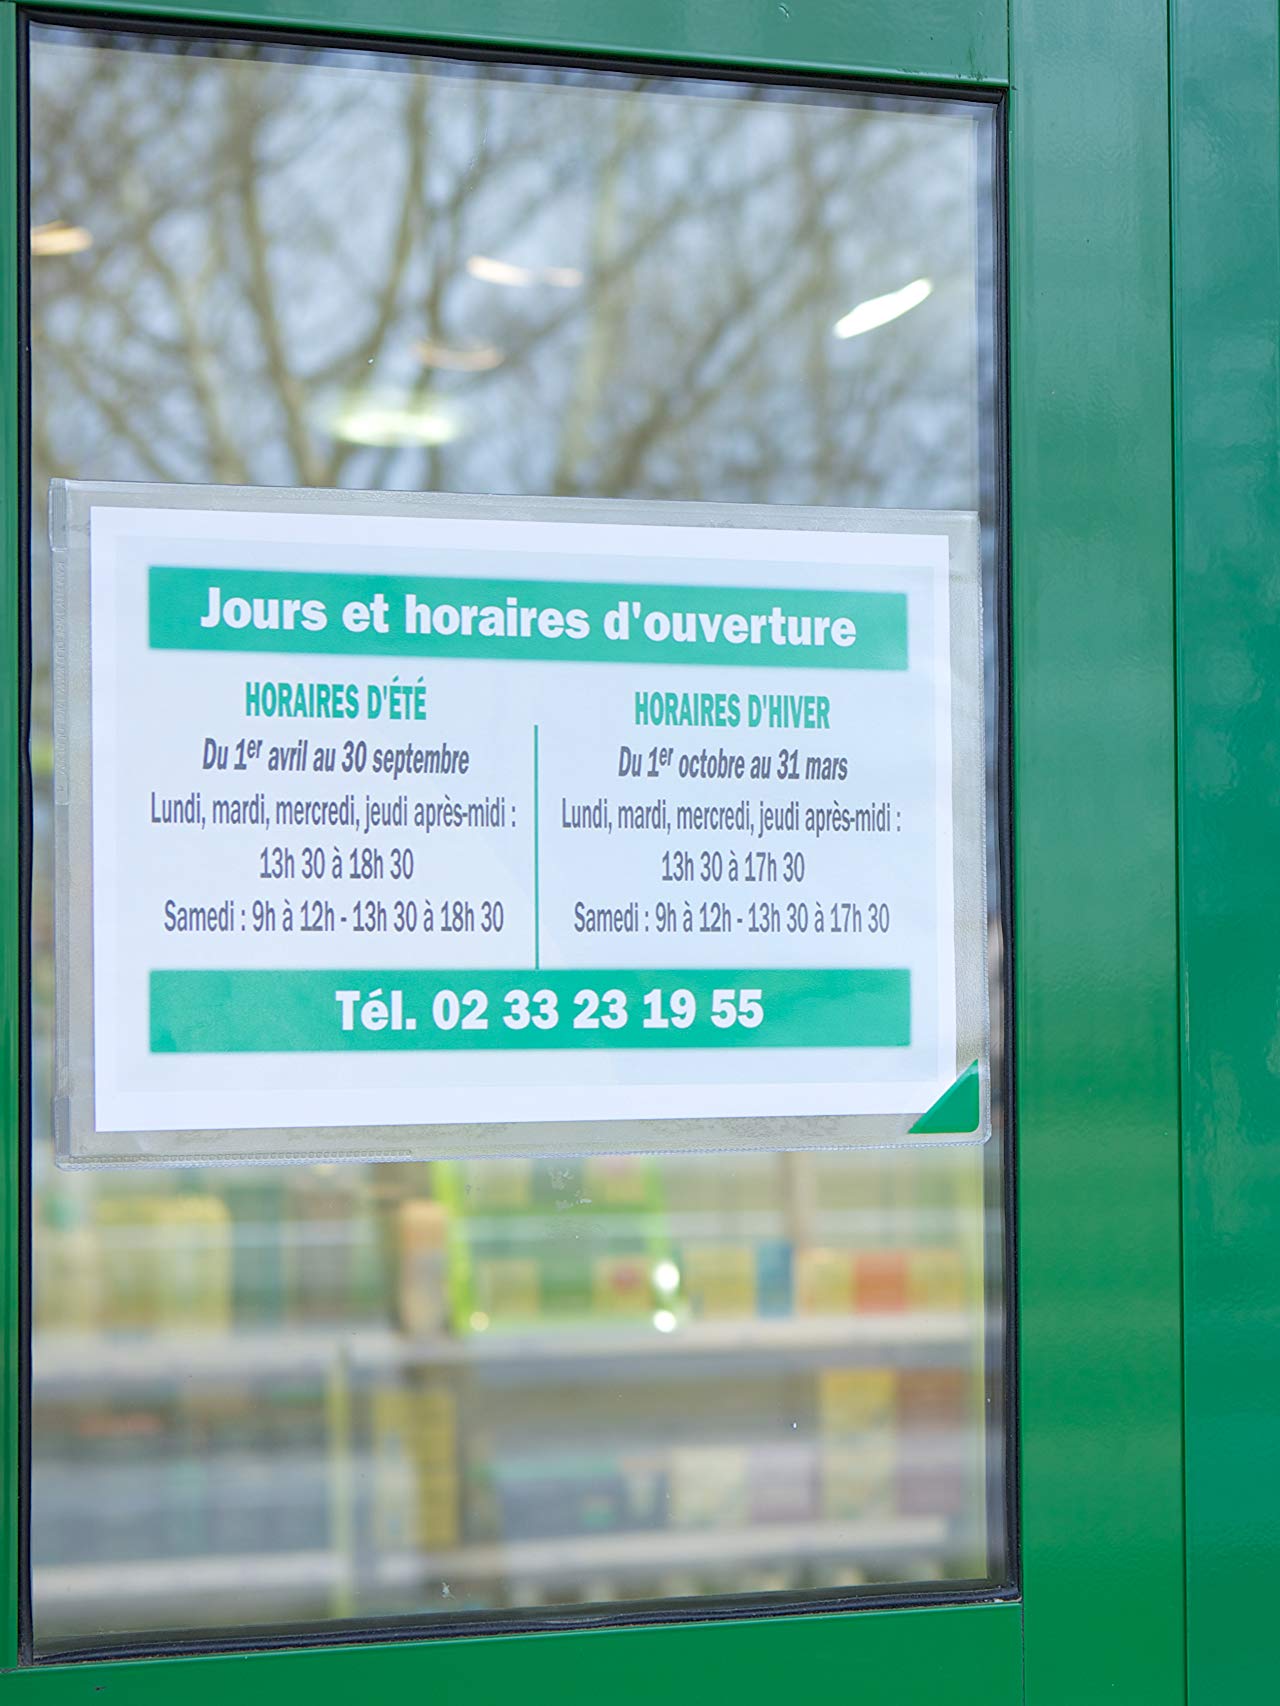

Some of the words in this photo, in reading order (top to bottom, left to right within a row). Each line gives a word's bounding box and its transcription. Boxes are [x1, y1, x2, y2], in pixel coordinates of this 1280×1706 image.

[201, 587, 327, 631] Jours
[342, 594, 389, 633] et
[406, 594, 590, 639] horaires
[604, 601, 856, 646] d'ouverture
[246, 682, 359, 718] HORAIRES
[368, 676, 426, 720] D'ÉTÉ
[636, 692, 740, 727] HORAIRES
[749, 695, 829, 728] D'HIVER
[203, 738, 228, 769] Du
[234, 739, 263, 770] 1er
[268, 740, 308, 771] avril
[313, 748, 336, 772] au
[342, 741, 367, 772] 30
[373, 743, 469, 780] septembre
[619, 746, 642, 777] Du
[647, 747, 673, 777] 1er
[679, 748, 744, 778] octobre
[751, 756, 771, 779] au
[777, 749, 799, 779] 31
[806, 757, 847, 780] mars
[152, 792, 205, 829] Lundi,
[213, 794, 269, 829] mardi,
[277, 795, 359, 830] mercredi,
[364, 795, 407, 834] jeudi
[415, 795, 504, 833] après-midi
[563, 798, 612, 834] Lundi,
[619, 799, 670, 834] mardi,
[677, 801, 754, 835] mercredi,
[758, 801, 799, 838] jeudi
[806, 800, 890, 837] après-midi
[261, 847, 294, 878] 13h
[302, 847, 325, 878] 30
[332, 846, 342, 878] à
[350, 848, 383, 879] 18h
[390, 848, 413, 879] 30
[662, 851, 693, 881] 13h
[701, 851, 722, 881] 30
[729, 850, 738, 881] à
[745, 852, 776, 881] 17h
[783, 852, 804, 882] 30
[165, 900, 234, 931] Samedi
[253, 900, 275, 931] 9h
[283, 899, 293, 931] à
[301, 900, 334, 931] 12h
[354, 901, 386, 932] 13h
[394, 901, 417, 932] 30
[424, 900, 433, 932] à
[441, 901, 474, 932] 18h
[481, 901, 503, 932] 30
[575, 902, 638, 932] Samedi
[656, 902, 676, 932] 9h
[683, 901, 692, 932] à
[700, 902, 731, 932] 12h
[749, 903, 780, 932] 13h
[787, 903, 808, 932] 30
[815, 902, 824, 932] à
[831, 903, 861, 932] 17h
[868, 903, 889, 933] 30
[336, 989, 416, 1030] Tél.
[433, 990, 488, 1030] 02
[503, 989, 558, 1029] 33
[574, 989, 628, 1029] 23
[643, 989, 696, 1028] 19
[711, 989, 763, 1028] 55
